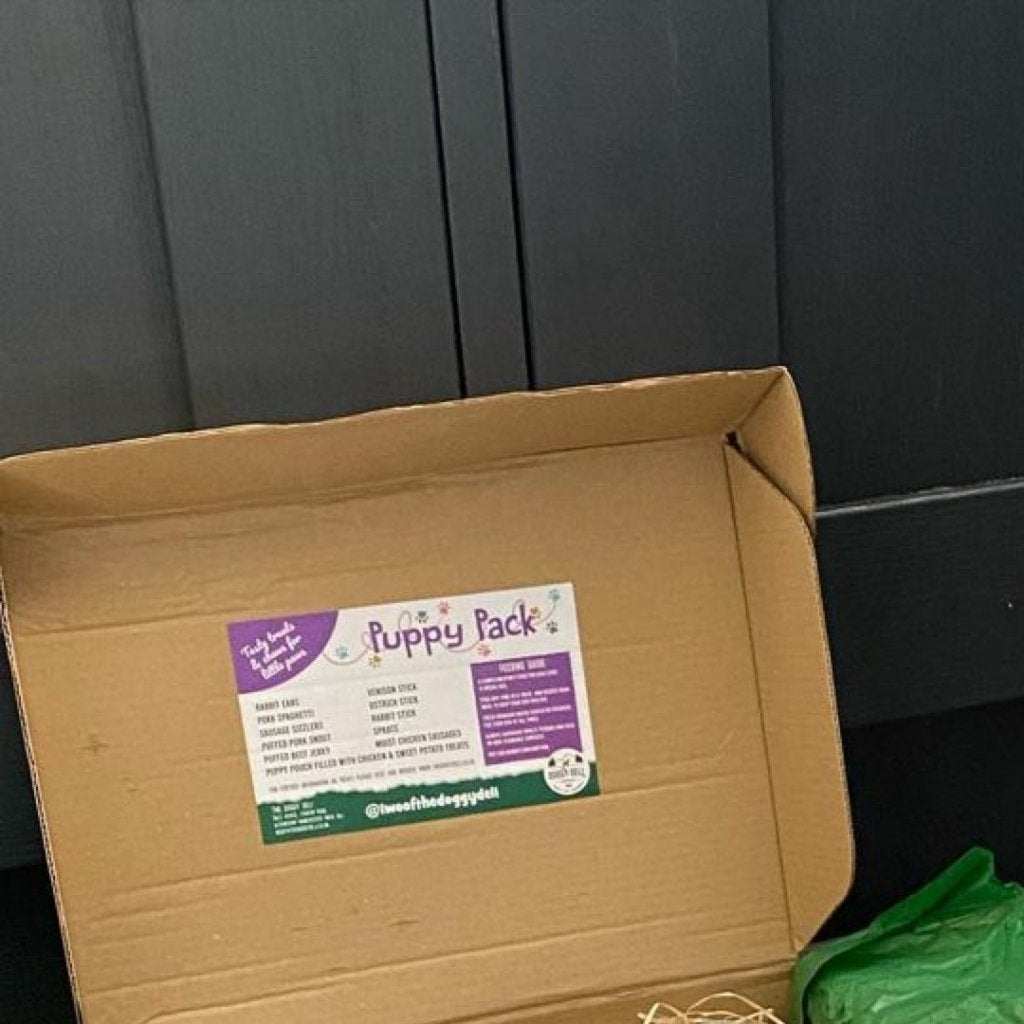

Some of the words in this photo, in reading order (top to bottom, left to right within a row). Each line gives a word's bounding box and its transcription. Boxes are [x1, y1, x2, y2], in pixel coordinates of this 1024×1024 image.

[368, 620, 464, 658] Puppy
[474, 604, 536, 641] Pack
[368, 686, 396, 696] VENISON
[398, 683, 416, 692] STICK
[256, 700, 279, 710] RABBIT
[282, 698, 300, 708] EARS
[370, 699, 397, 710] OSTRICH
[400, 696, 418, 706] STICK
[258, 714, 276, 724] PORK
[276, 709, 315, 722] SPAGHETTI
[372, 712, 395, 722] RABBIT
[398, 710, 416, 719] STICK
[260, 726, 290, 737] SAUSAGE
[292, 722, 323, 734] SIZZLERS
[373, 724, 398, 734] SPRATS
[262, 740, 286, 750] PUFFED
[288, 738, 306, 747] PORK
[309, 733, 330, 744] SNOUT
[375, 737, 395, 748] MOIST
[398, 734, 427, 745] CHICKEN
[428, 730, 462, 740] SAUSAGES
[264, 752, 289, 763] PUFFED
[292, 749, 308, 760] BEEF
[310, 746, 330, 757] JERKY
[265, 766, 288, 776] PUPPY
[290, 763, 312, 772] POUCH
[314, 758, 337, 769] FILLED
[338, 756, 356, 766] WITH
[358, 752, 387, 764] CHICKEN
[395, 747, 417, 758] SWEET
[419, 744, 444, 754] POTATO
[446, 741, 469, 751] TREATS
